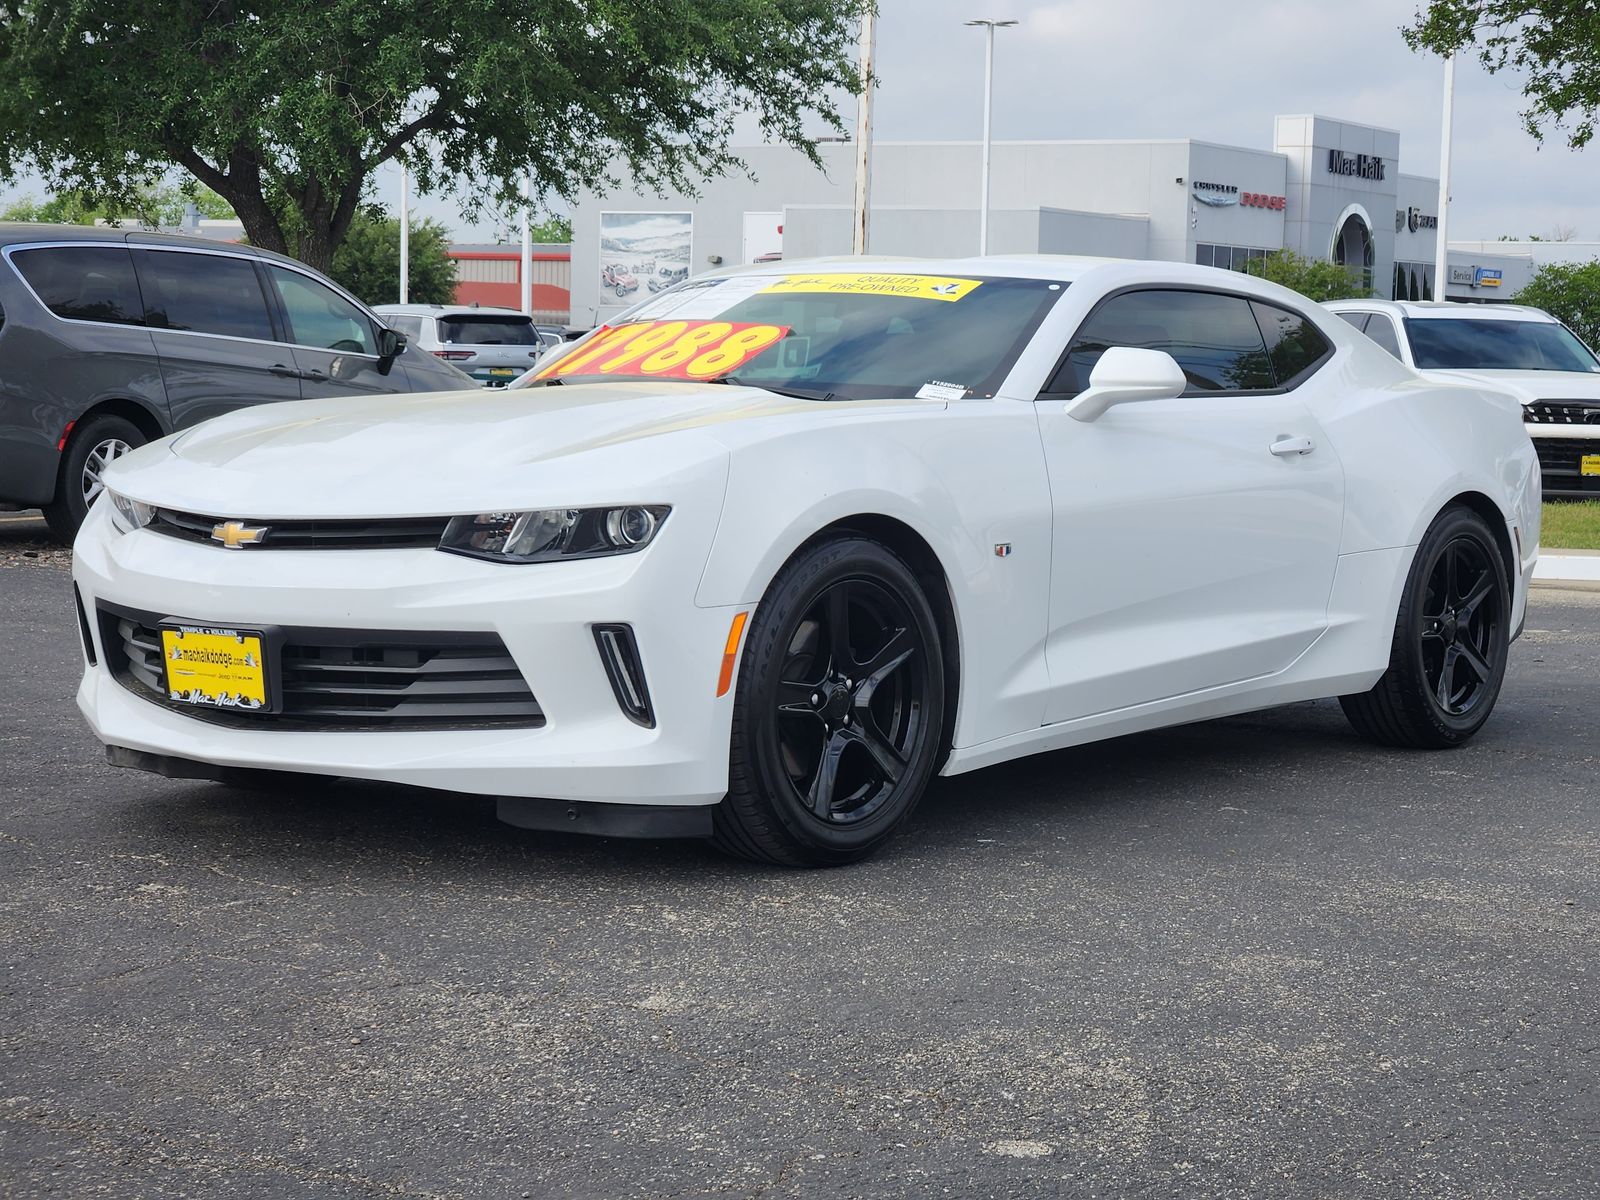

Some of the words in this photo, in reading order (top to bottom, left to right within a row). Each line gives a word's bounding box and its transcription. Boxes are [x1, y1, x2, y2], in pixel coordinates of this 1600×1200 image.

[1328, 148, 1356, 176] Mac
[1356, 153, 1386, 181] Haik
[1240, 192, 1286, 211] DODGE
[857, 274, 925, 285] QUALITY
[1453, 270, 1472, 281] Service
[829, 282, 920, 294] PRE-OWNED
